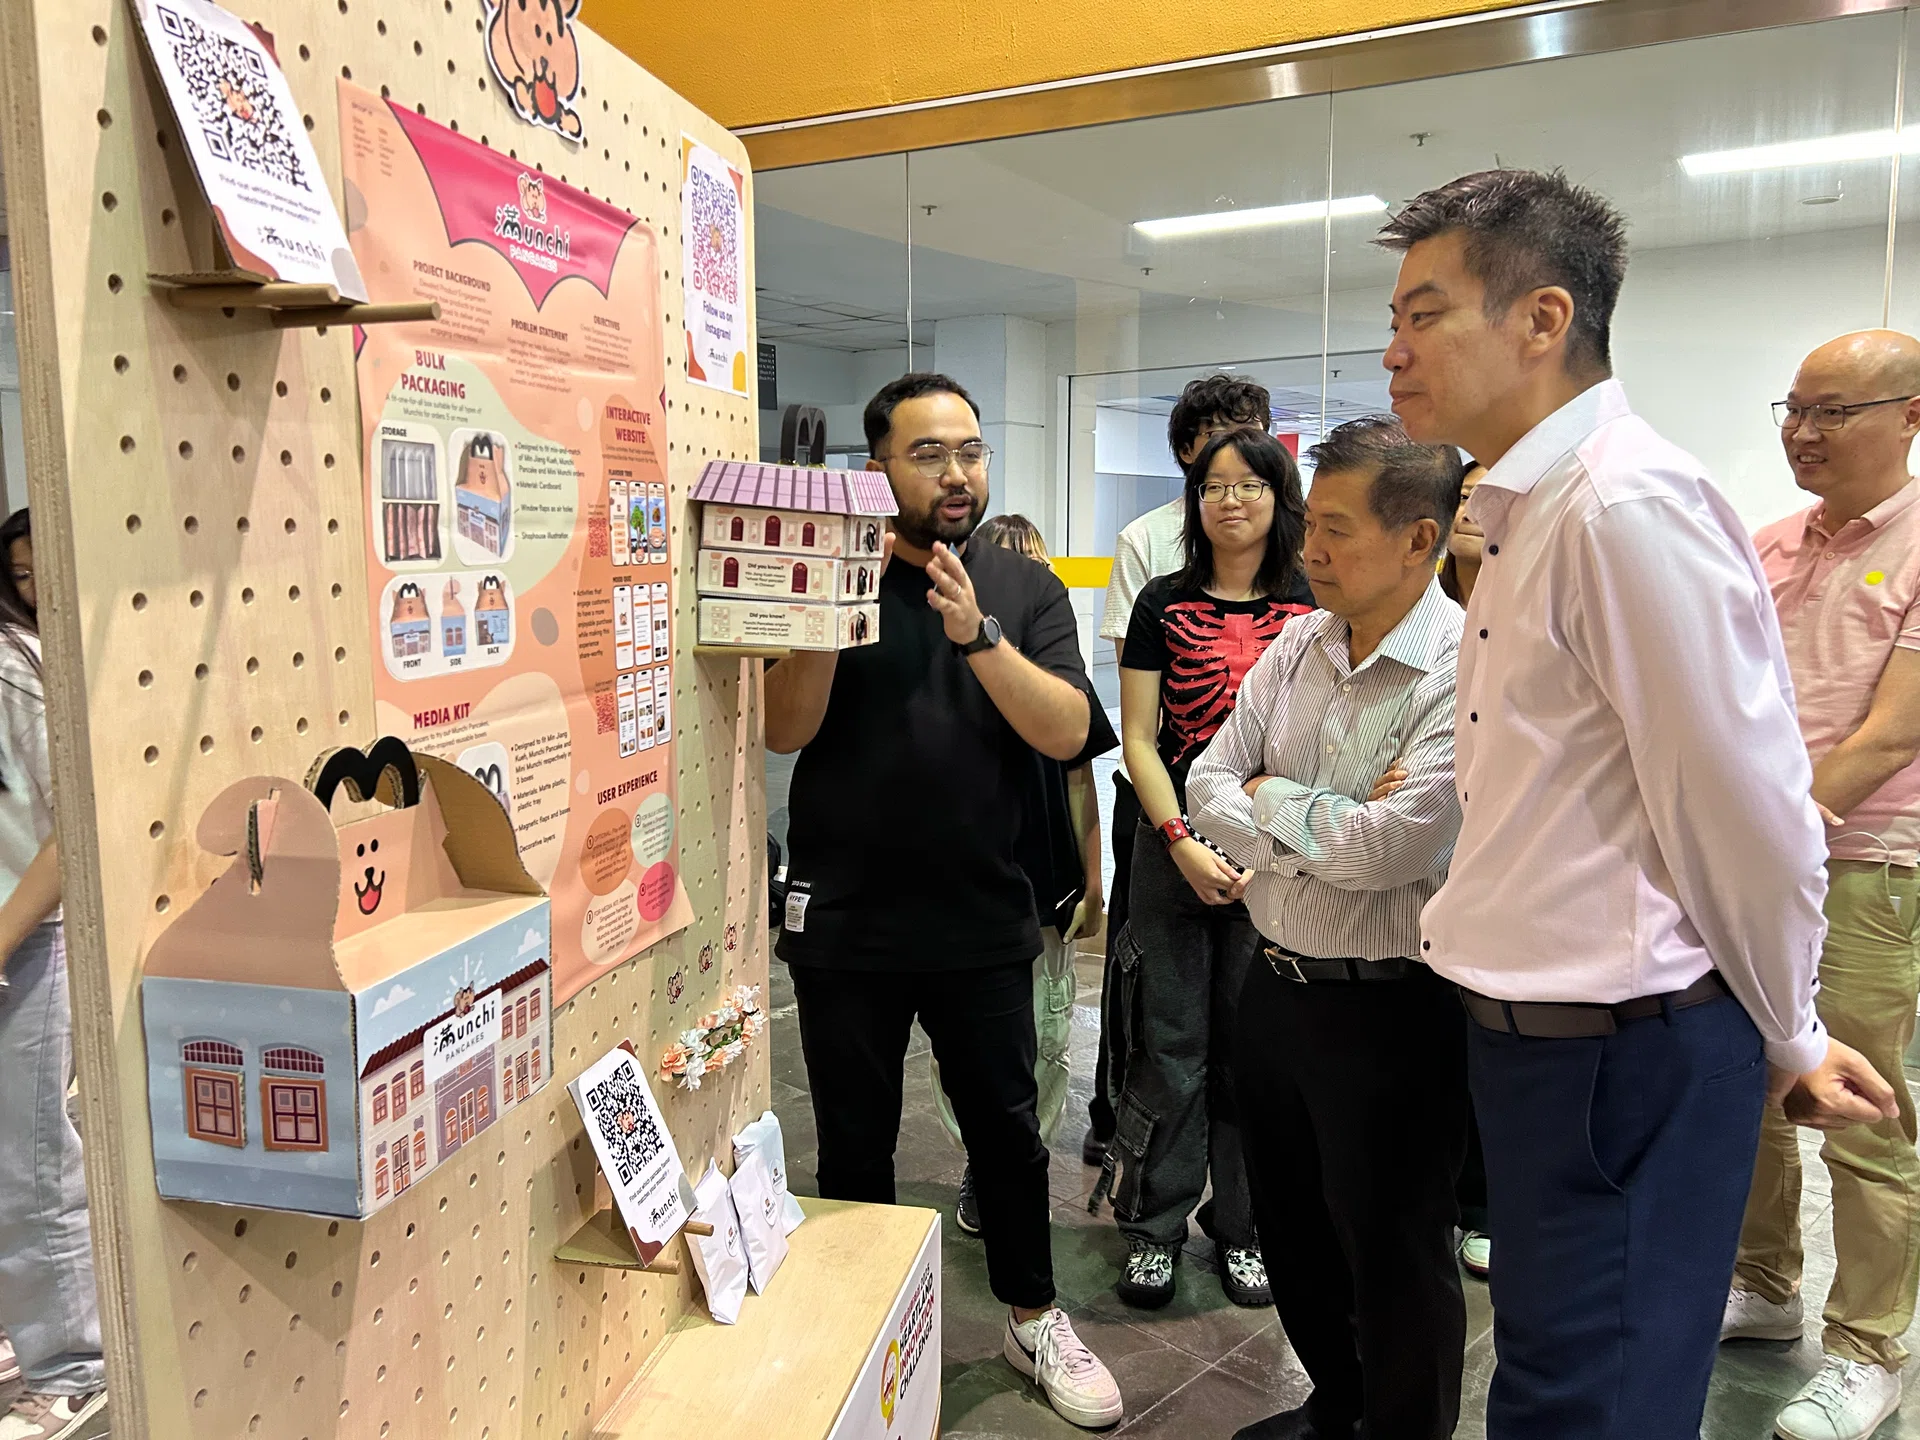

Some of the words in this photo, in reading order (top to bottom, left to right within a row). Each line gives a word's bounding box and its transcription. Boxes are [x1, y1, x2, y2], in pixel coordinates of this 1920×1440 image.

[413, 260, 443, 278] PROJECT
[445, 269, 491, 292] BACKGROUND
[703, 300, 718, 317] Follow
[719, 310, 725, 320] us
[726, 313, 733, 323] on
[511, 318, 538, 334] PROBLEM
[539, 326, 568, 342] STATEMENT
[415, 350, 446, 371] BULK
[401, 373, 465, 399] PACKAGING
[606, 405, 651, 425] INTERACTIVE
[381, 426, 407, 437] STORAGE
[615, 427, 646, 443] WEBSITE
[450, 658, 462, 666] SIDE
[487, 647, 499, 655] BACK
[403, 659, 421, 669] FRONT
[414, 707, 450, 729] MEDIA
[453, 702, 470, 721] KIT
[514, 740, 535, 752] Designed
[597, 786, 616, 805] USER
[618, 770, 658, 797] EXPERIENCE
[518, 819, 538, 832] Magnetic
[519, 838, 543, 853] Decorative
[445, 1032, 485, 1063] PANCAKES
[899, 1272, 933, 1356] HEARTLAND
[900, 1287, 935, 1379] INNOVATION
[899, 1313, 933, 1400] CHALLENGE
